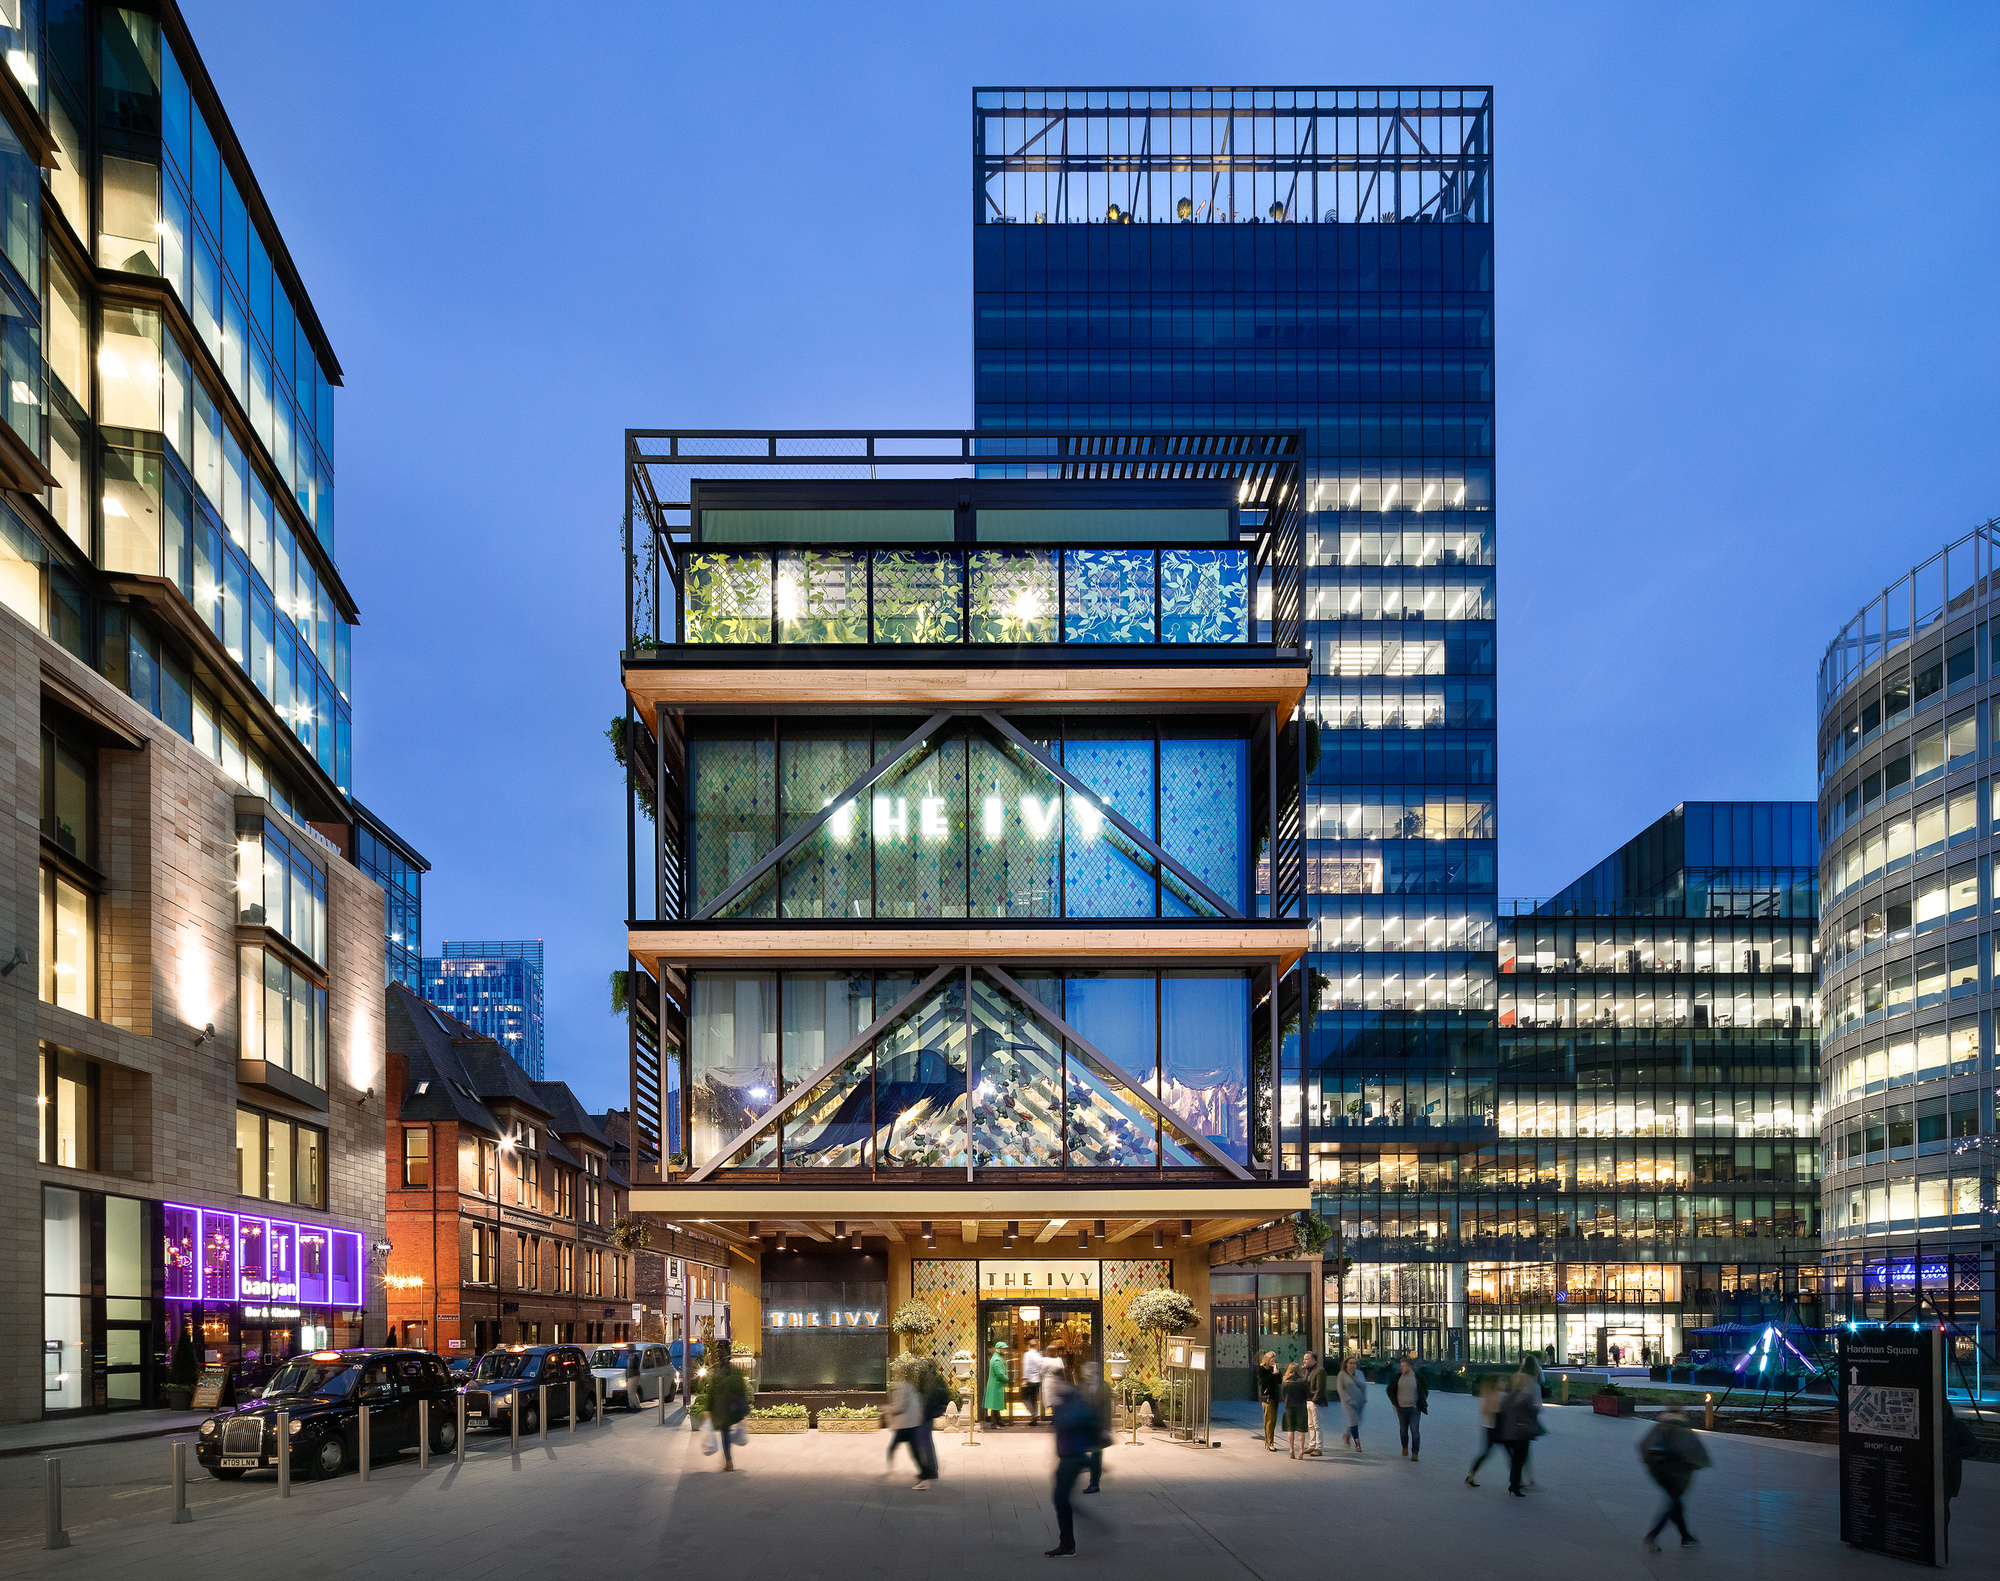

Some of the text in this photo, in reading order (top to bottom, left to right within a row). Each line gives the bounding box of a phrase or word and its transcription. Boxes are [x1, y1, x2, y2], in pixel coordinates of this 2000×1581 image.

[823, 797, 1111, 835] THE IVY
[986, 1272, 1093, 1286] THE IVY
[241, 1277, 296, 1299] banyan
[245, 1306, 300, 1317] Bar & Kitchen
[769, 1312, 879, 1327] THE IVY
[1846, 1345, 1919, 1356] Hardman Square
[1863, 1442, 1883, 1450] SHOP
